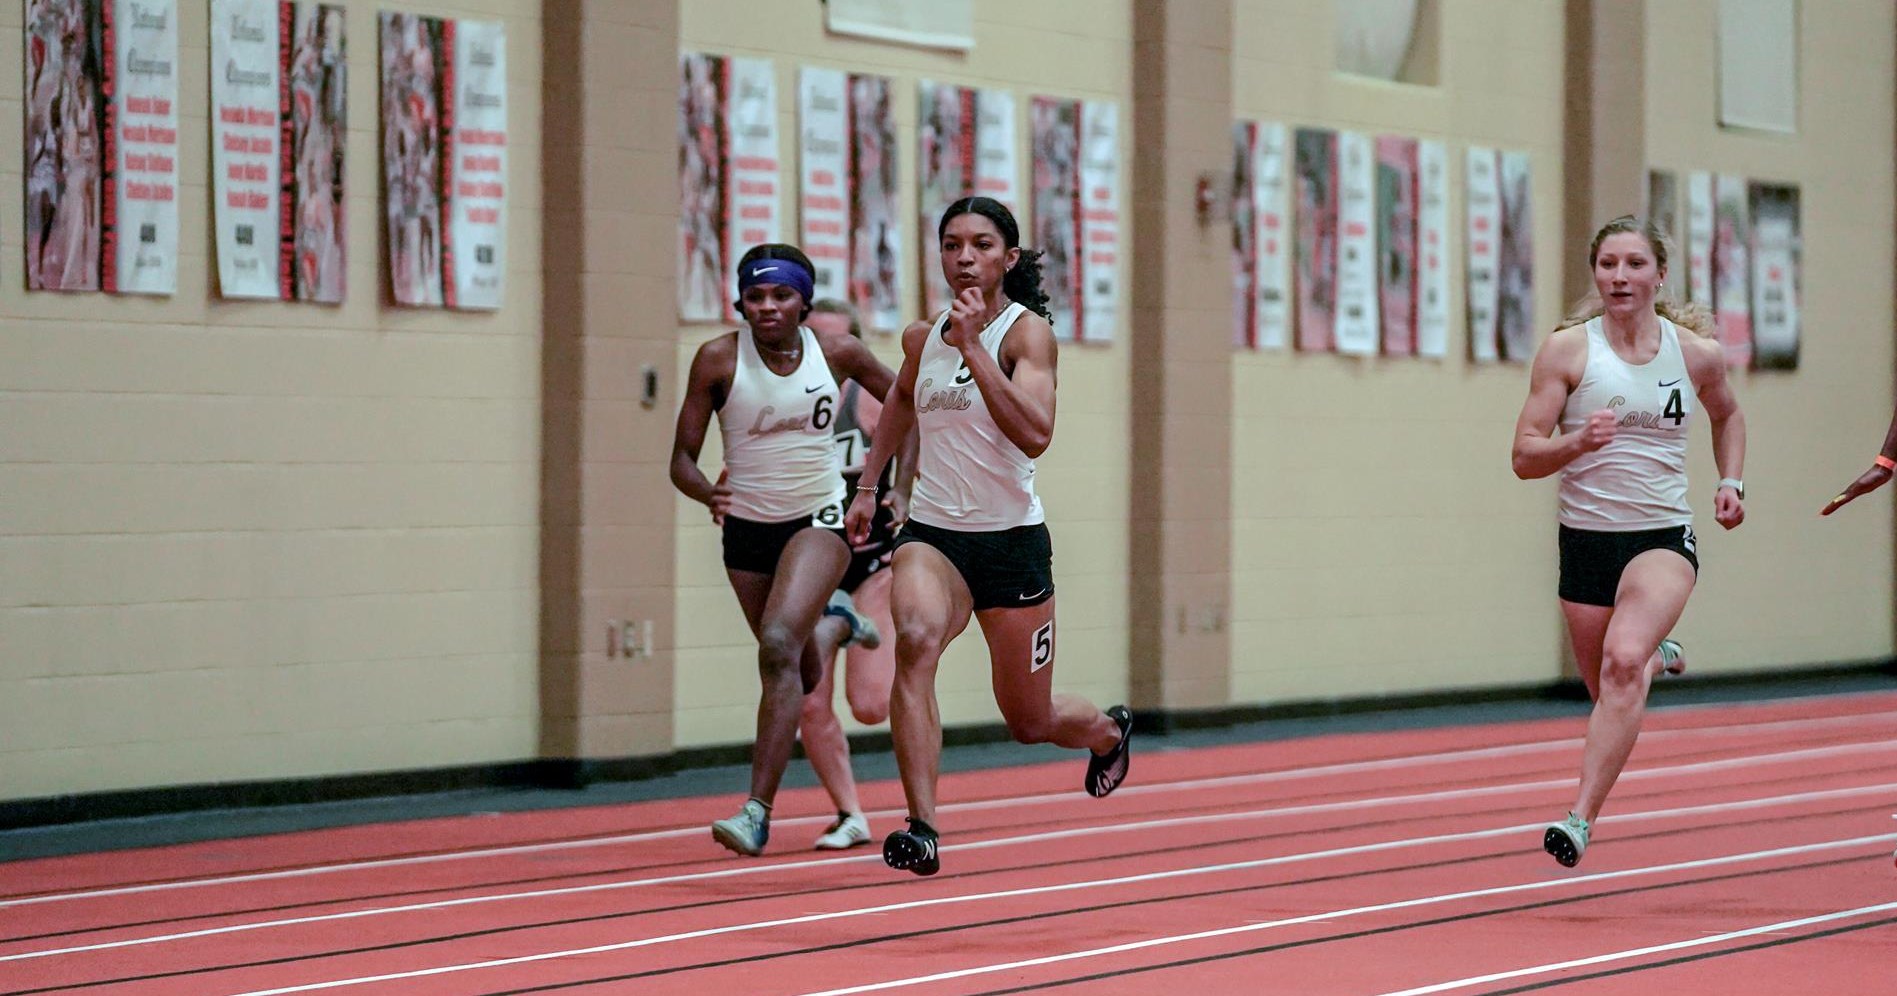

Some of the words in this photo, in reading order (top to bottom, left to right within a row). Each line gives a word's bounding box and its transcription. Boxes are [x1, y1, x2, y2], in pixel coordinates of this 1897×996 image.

[813, 395, 832, 430] 6
[1664, 388, 1685, 425] 4
[836, 435, 855, 466] 7
[817, 504, 838, 525] 6
[1035, 624, 1050, 665] 5
